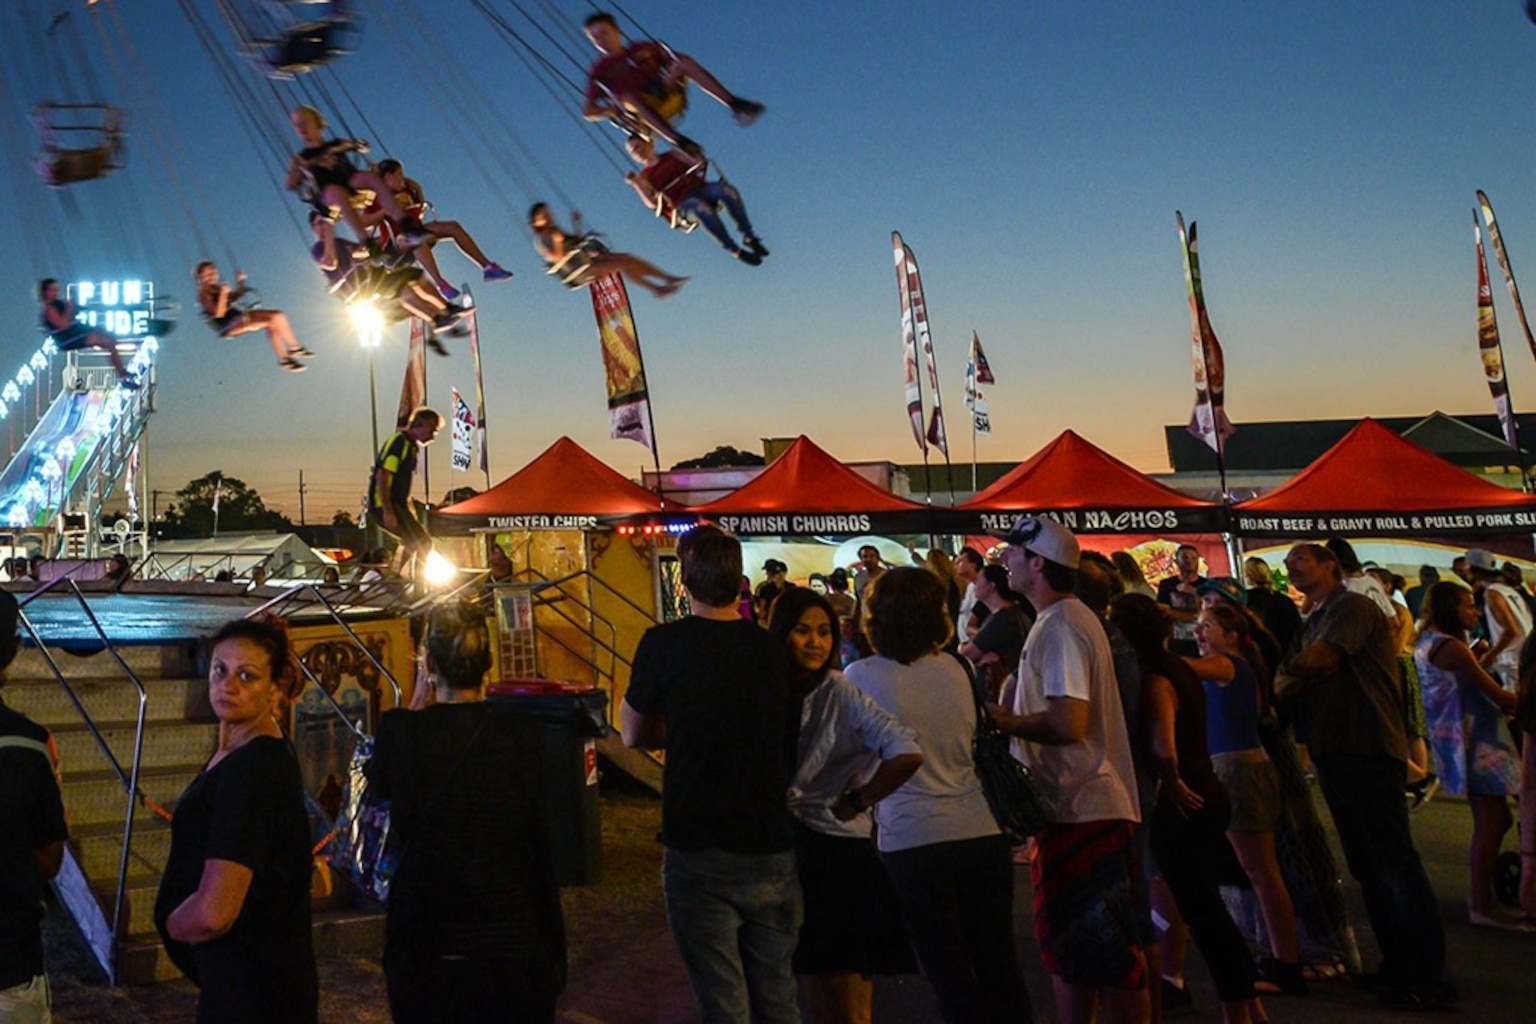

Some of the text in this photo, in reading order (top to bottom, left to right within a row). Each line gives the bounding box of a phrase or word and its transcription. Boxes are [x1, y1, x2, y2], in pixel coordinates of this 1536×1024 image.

[553, 516, 597, 527] CHIPS
[719, 514, 871, 532] SPANISH CHURROS
[980, 510, 1178, 530] MEXAN NACHOS
[1240, 517, 1279, 530] ROAST
[1282, 519, 1313, 530] BEEF
[1317, 518, 1327, 531] &
[1330, 517, 1372, 531] GRAVY
[1375, 517, 1408, 530] ROLL
[1411, 517, 1422, 528] &
[1424, 515, 1473, 528] PULLED
[1476, 513, 1513, 526] PORK
